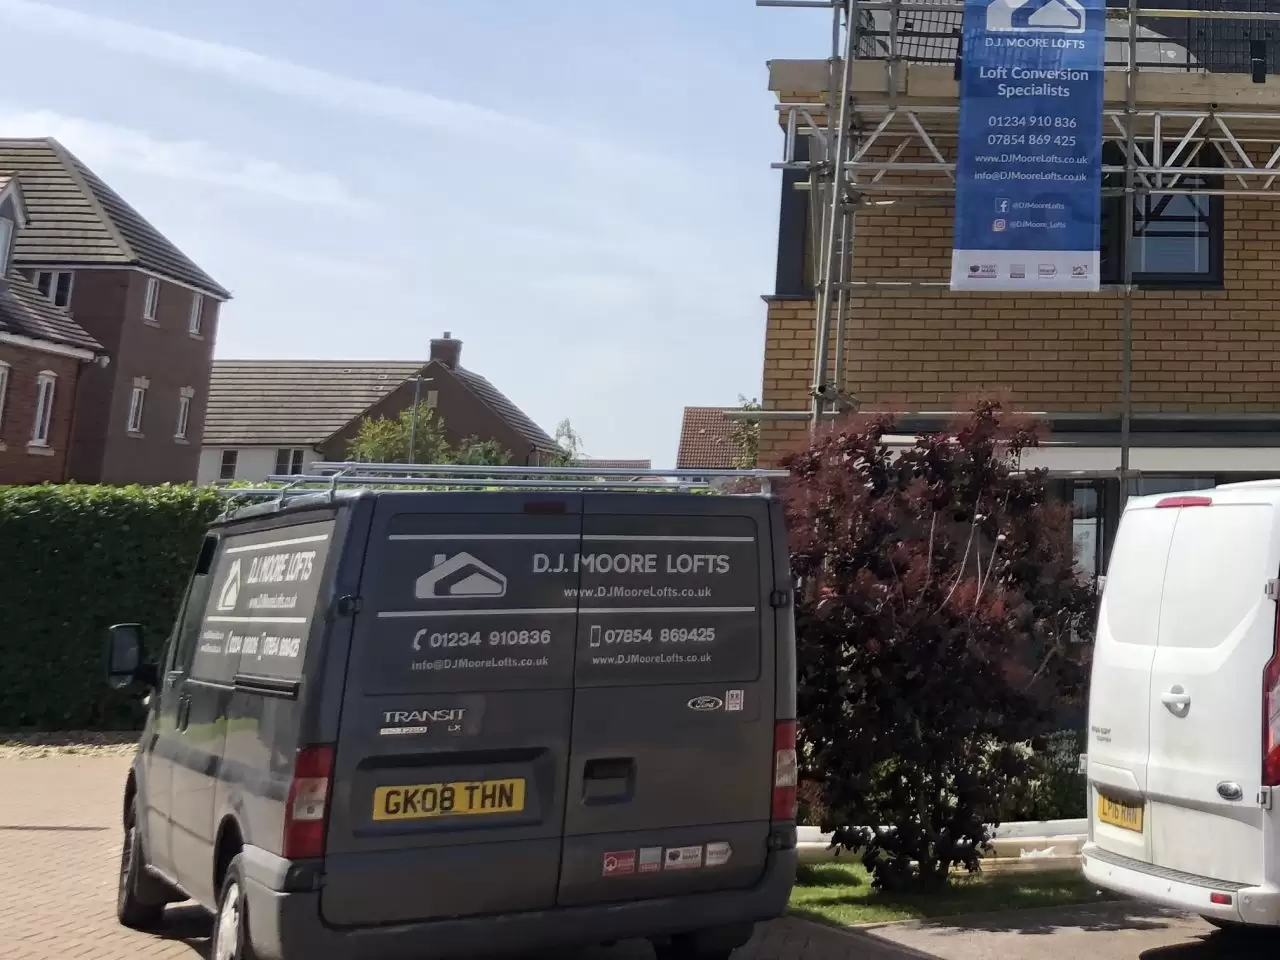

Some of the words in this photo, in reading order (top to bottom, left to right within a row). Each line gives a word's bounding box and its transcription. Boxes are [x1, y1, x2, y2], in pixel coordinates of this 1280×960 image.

[1006, 38, 1050, 48] MOORE
[1051, 39, 1085, 49] LOFTS
[980, 66, 1008, 79] Loft
[1011, 66, 1089, 81] Conversion
[997, 83, 1071, 98] Specialists
[988, 116, 1026, 127] 01234
[1030, 116, 1052, 127] 910
[1054, 117, 1077, 128] 836
[987, 134, 1025, 145] 07854
[1028, 134, 1051, 145] 869
[1053, 135, 1076, 146] 425
[974, 154, 1088, 165] www.DJMooreLofts.co.uk
[973, 171, 1087, 182] info@DJMooreLofts.co.uk
[285, 550, 317, 581] LOFTS
[532, 553, 569, 573] D.J.
[573, 553, 658, 573] MOORE
[666, 553, 730, 574] LOFTS
[563, 586, 712, 598] www.DJMooreLofts.co.uk
[430, 631, 482, 648] 01234
[489, 629, 552, 646] 910836
[604, 629, 654, 644] 07854
[659, 627, 716, 643] 869425
[411, 656, 549, 671] info@DJMooreLofts.co.uk
[592, 653, 712, 665] www.DJMooreLofts.co.uk
[383, 708, 467, 723] TRANSIT
[384, 785, 456, 815] GK08
[464, 783, 515, 809] THN
